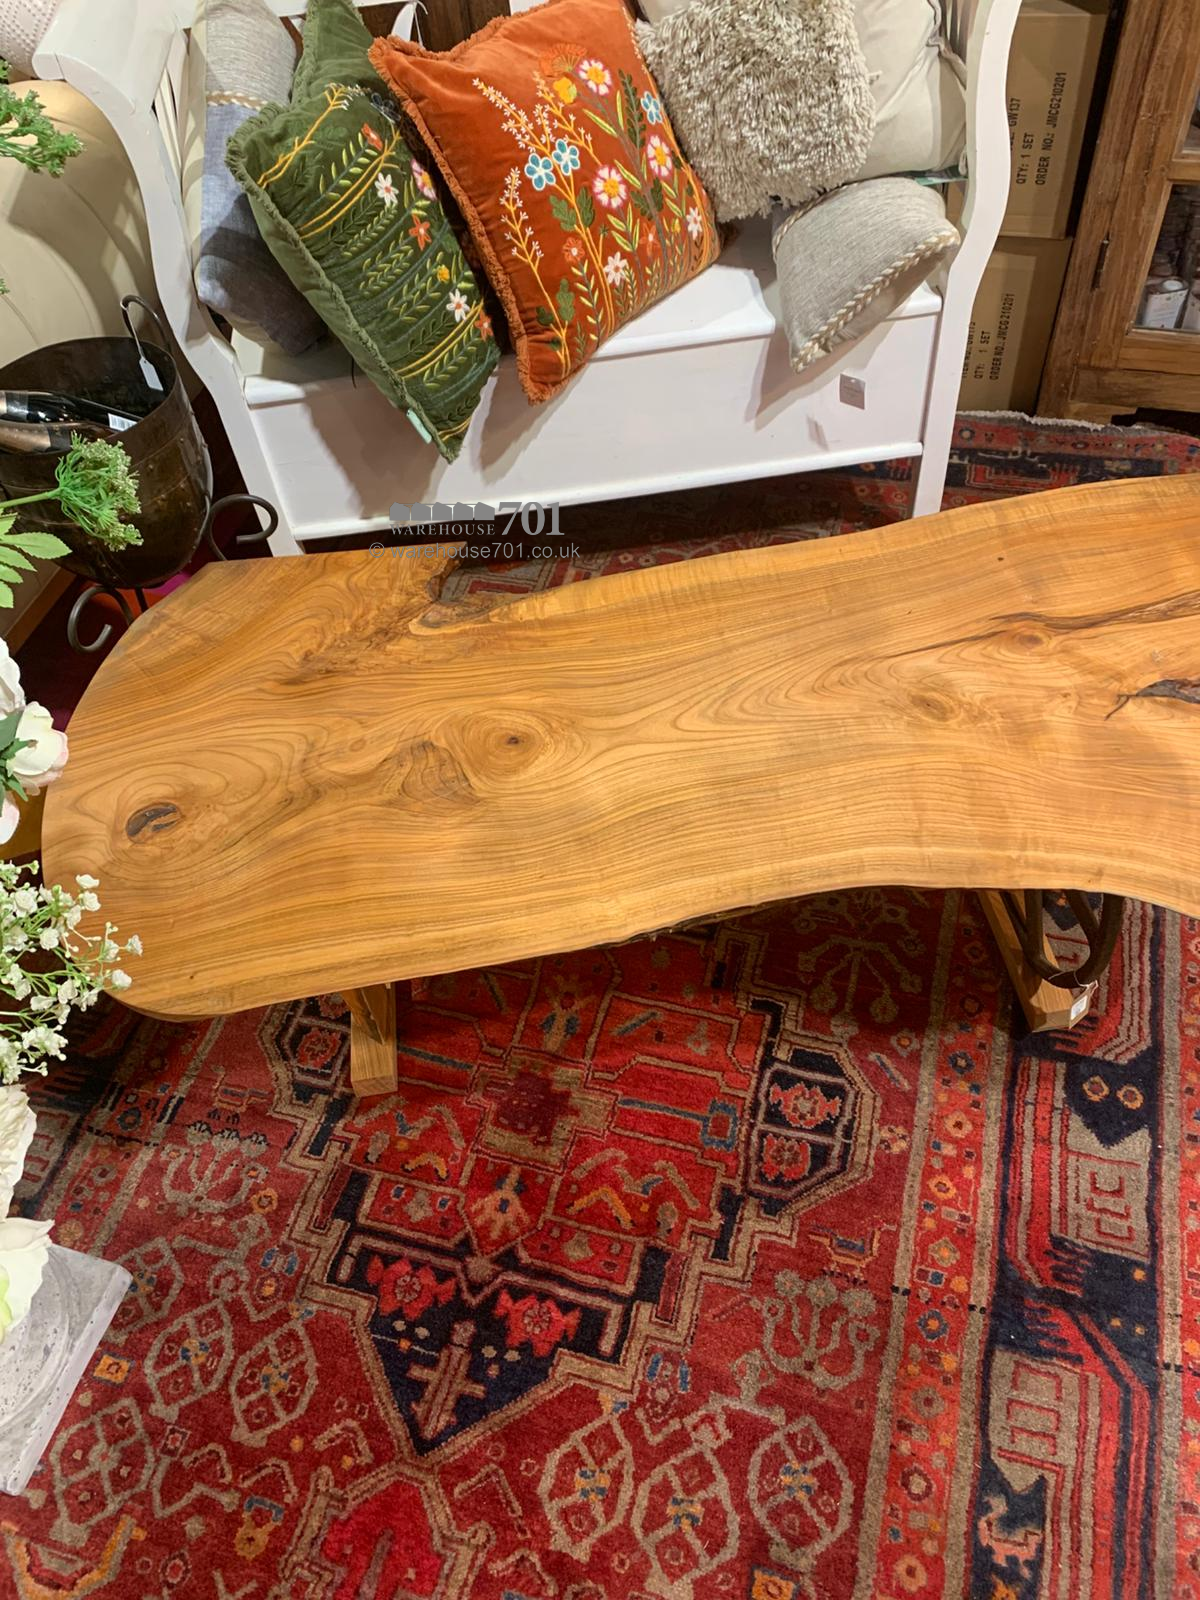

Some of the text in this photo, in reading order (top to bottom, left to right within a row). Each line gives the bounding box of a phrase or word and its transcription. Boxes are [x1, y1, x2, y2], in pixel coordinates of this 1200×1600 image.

[1022, 132, 1035, 150] SET
[1035, 156, 1051, 186] ORDER
[1046, 72, 1067, 128] JMCG210201
[1016, 163, 1029, 185] QTY:
[974, 363, 985, 379] QTY:
[980, 330, 991, 344] SET
[989, 357, 1002, 380] ORDER
[997, 293, 1015, 340] JMCG210201
